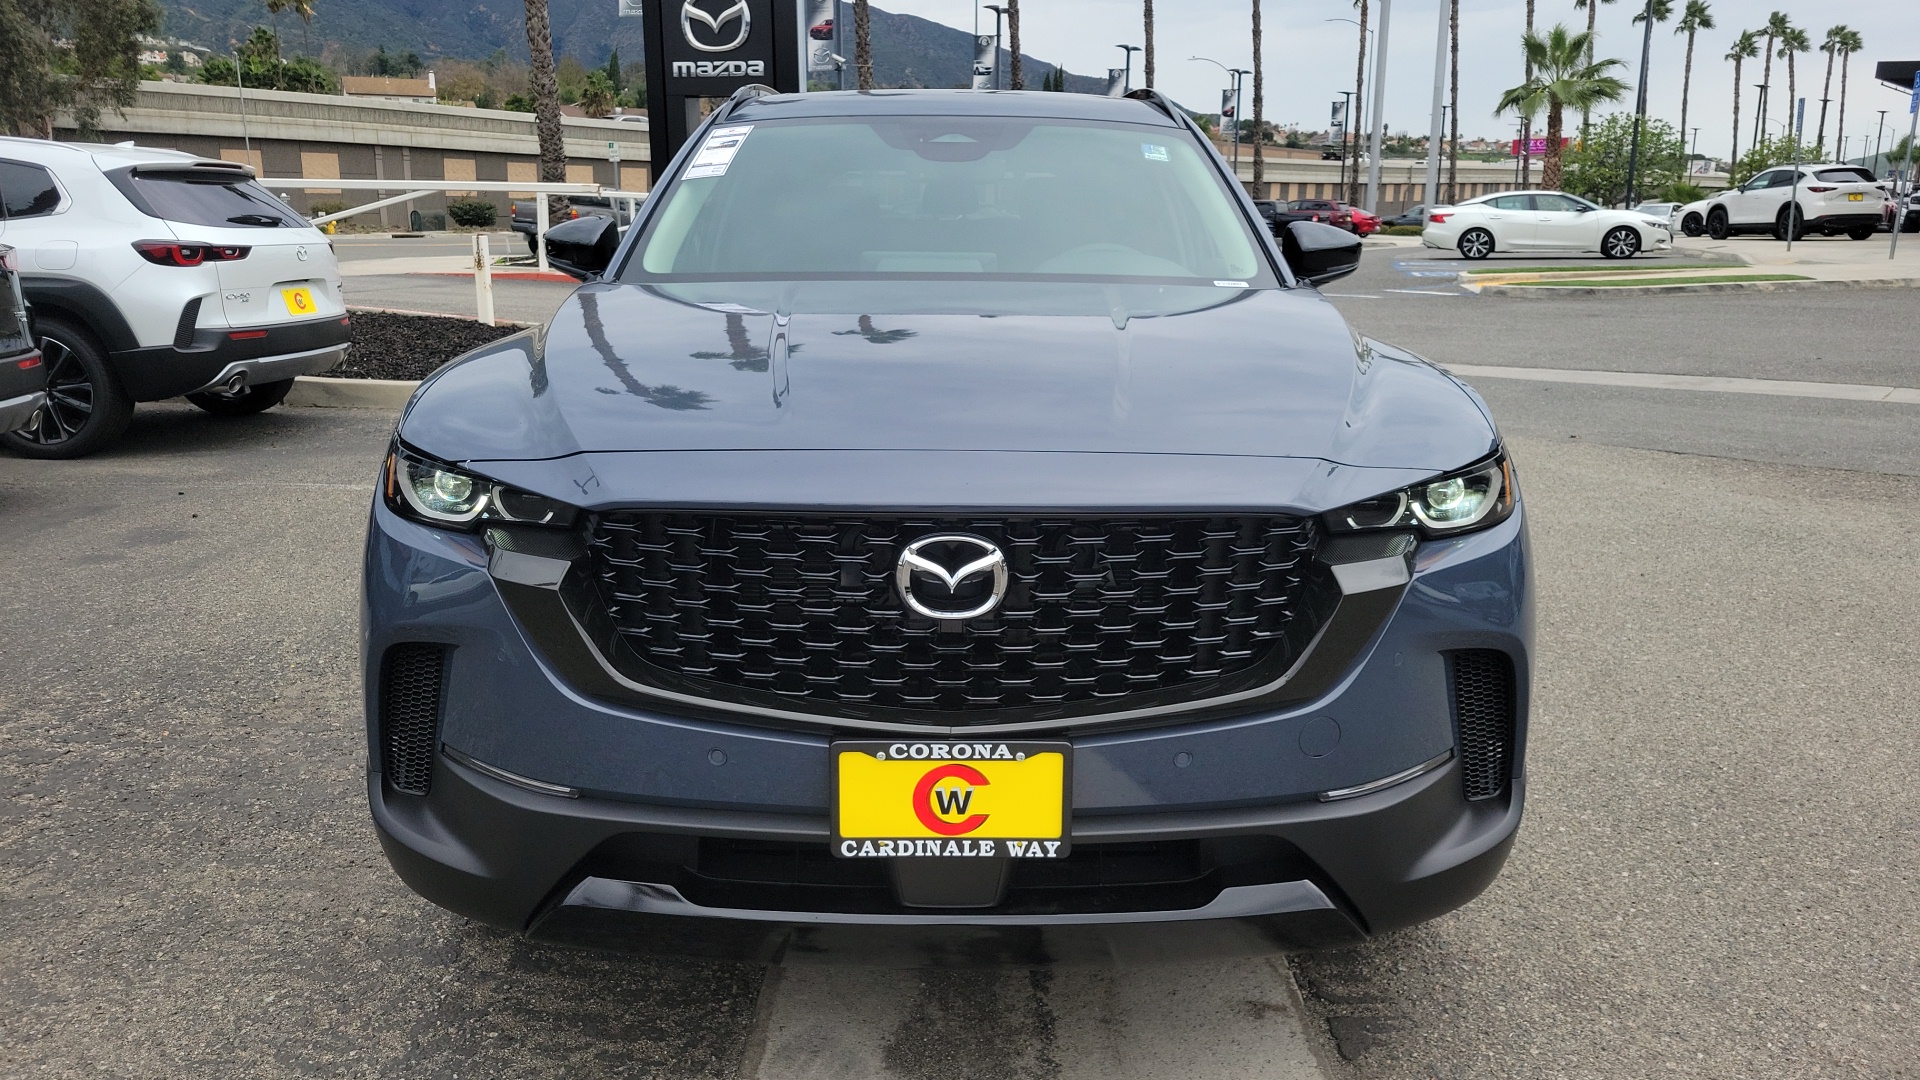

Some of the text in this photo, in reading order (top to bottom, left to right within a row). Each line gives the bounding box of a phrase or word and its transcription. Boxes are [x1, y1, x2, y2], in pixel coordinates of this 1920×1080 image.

[672, 60, 765, 78] mazda
[889, 743, 1013, 759] CORONA
[840, 840, 1061, 858] CARDINALE WAY
